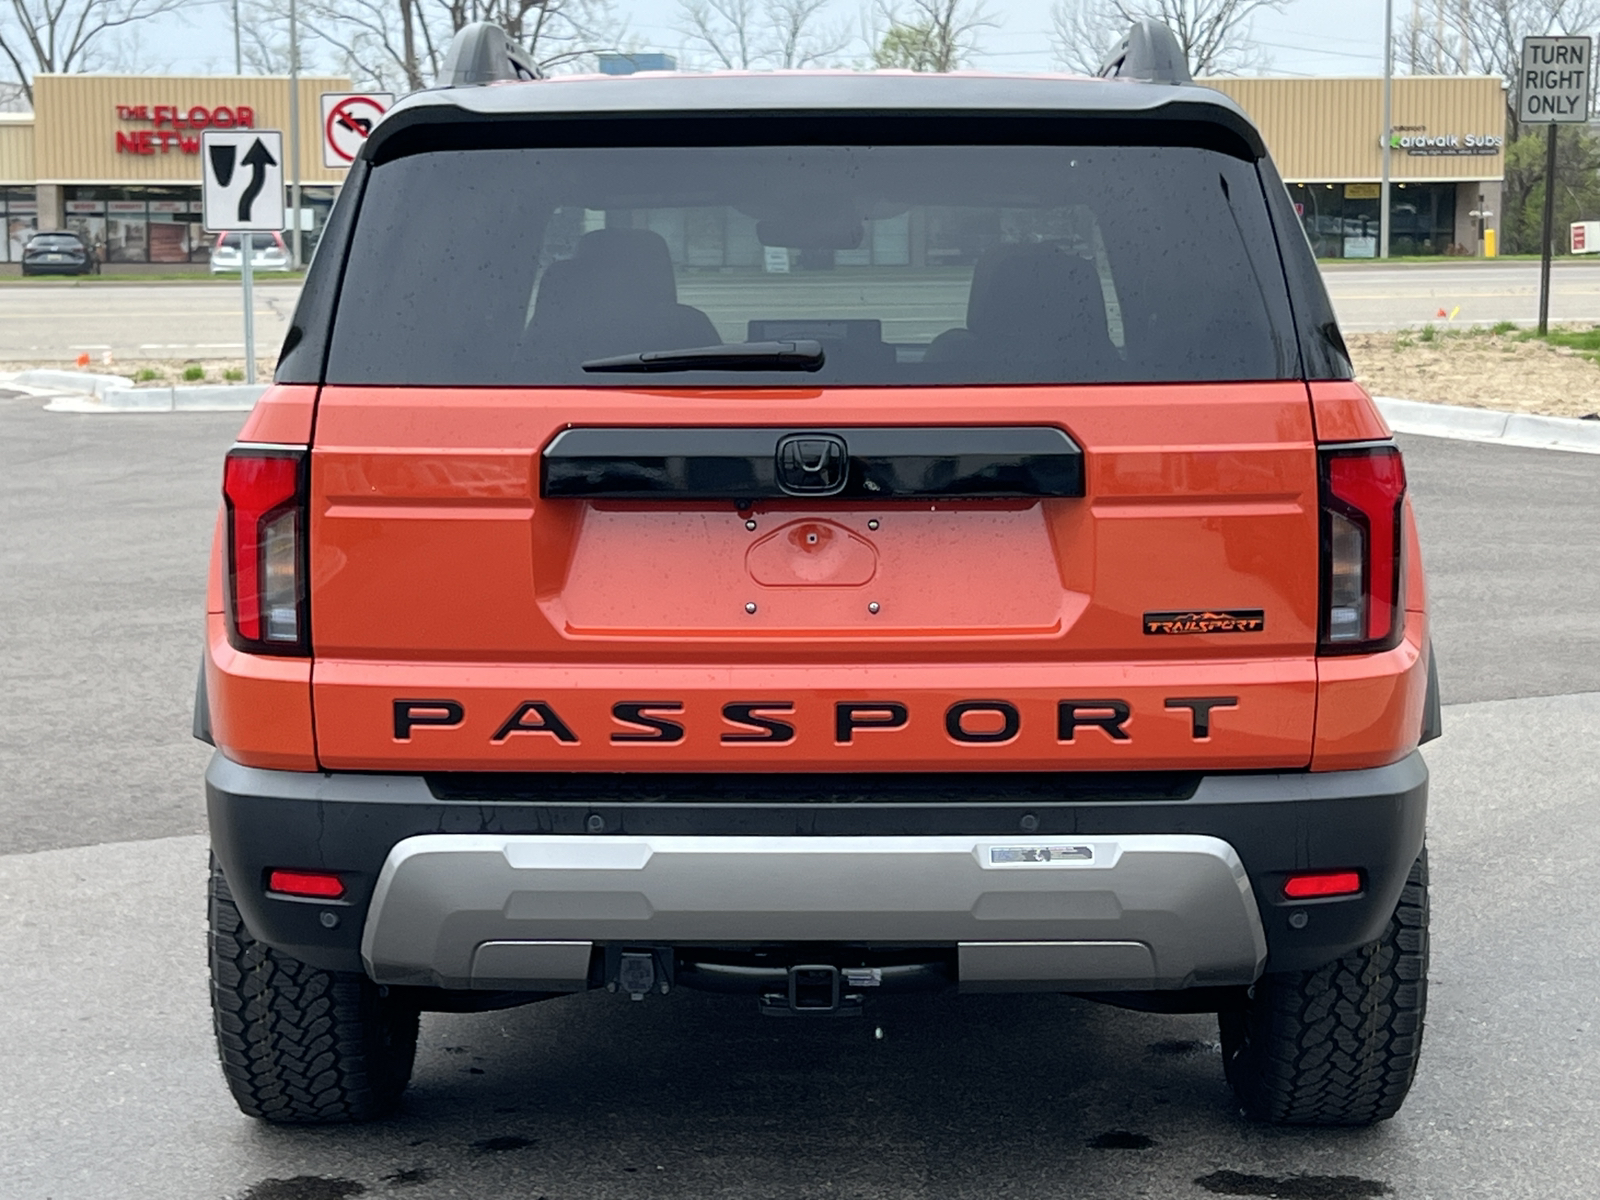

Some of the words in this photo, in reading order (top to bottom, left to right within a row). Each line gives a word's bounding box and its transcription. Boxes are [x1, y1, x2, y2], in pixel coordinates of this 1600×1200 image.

[1529, 45, 1584, 64] TURN
[1525, 70, 1585, 89] RIGHT
[1527, 95, 1580, 114] ONLY
[116, 105, 149, 119] THE
[153, 106, 254, 129] FLOOR
[1379, 134, 1459, 148] ardwalk
[1464, 133, 1503, 148] Subs
[1147, 620, 1262, 633] TRAILSPORT
[392, 696, 1241, 749] PASSPORT
